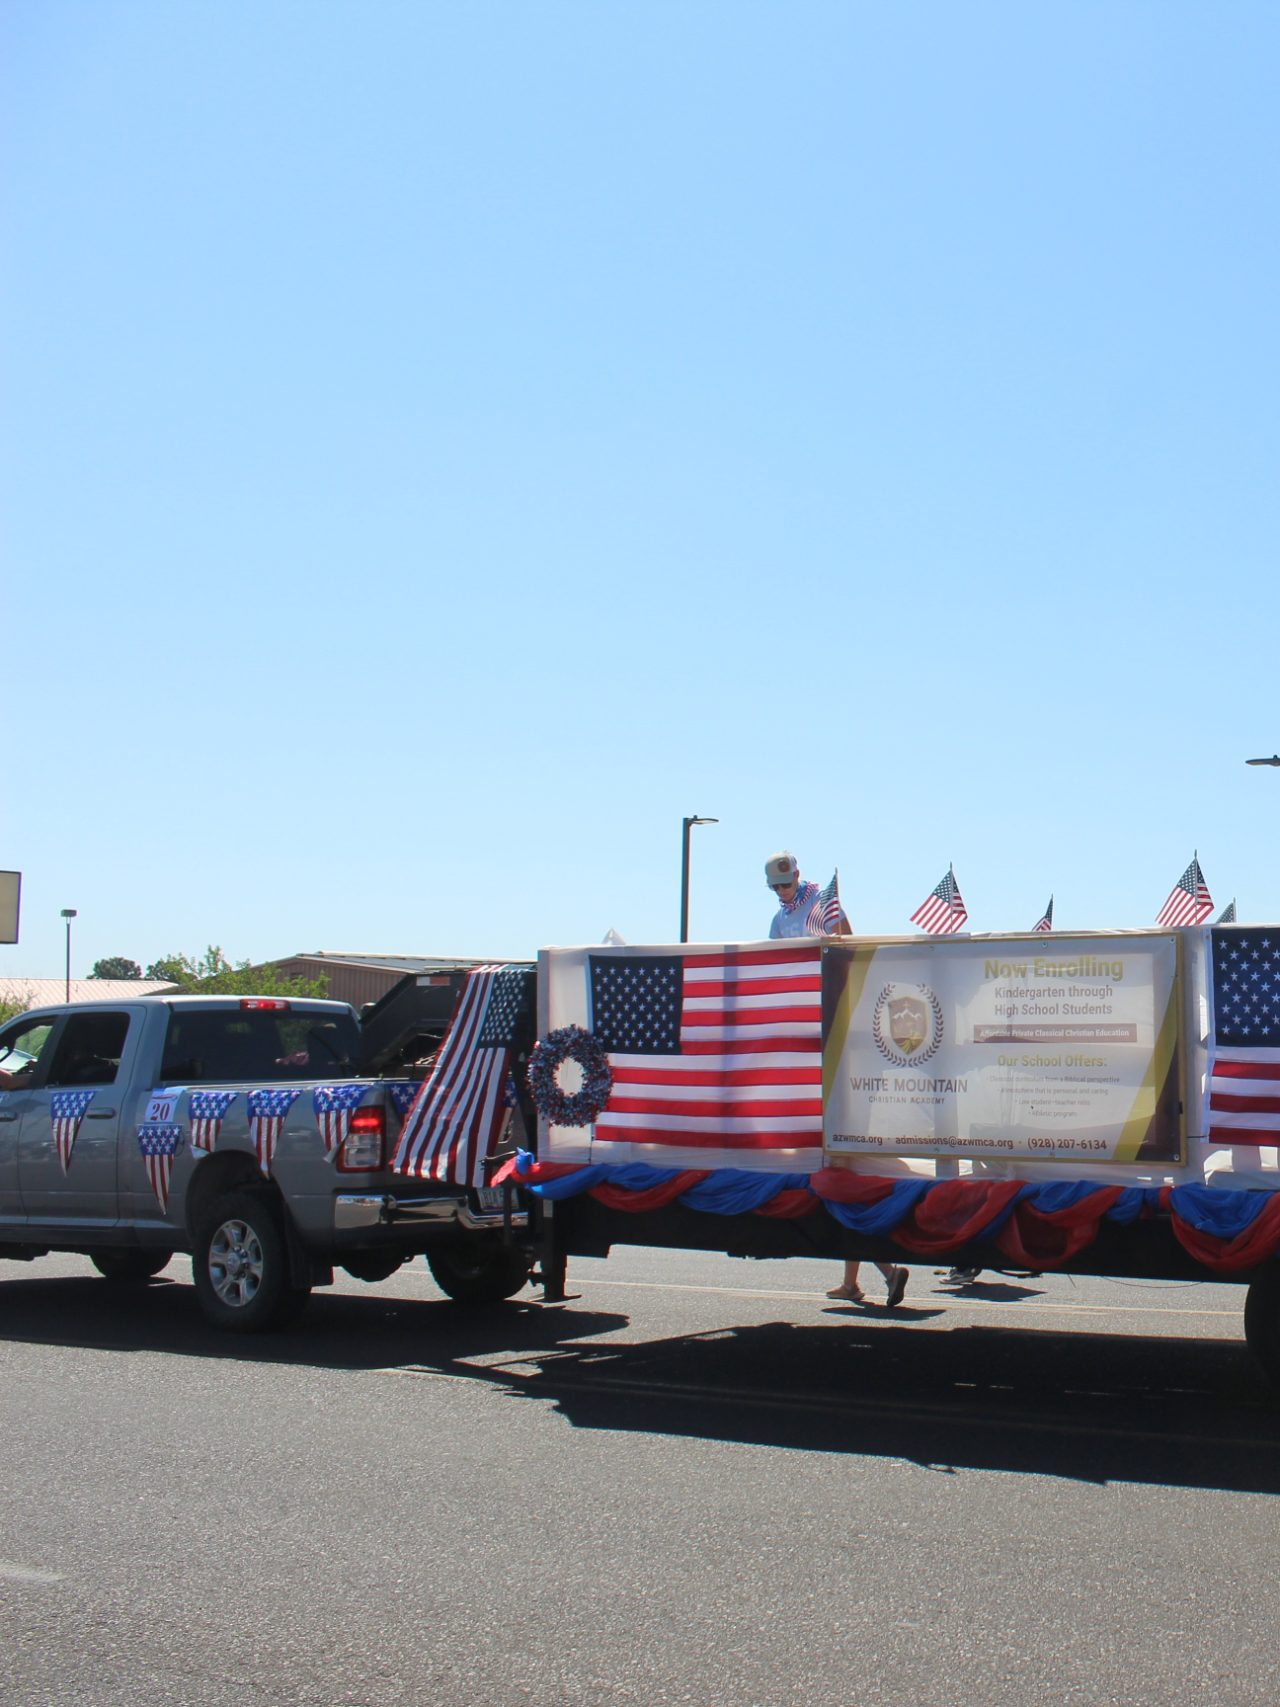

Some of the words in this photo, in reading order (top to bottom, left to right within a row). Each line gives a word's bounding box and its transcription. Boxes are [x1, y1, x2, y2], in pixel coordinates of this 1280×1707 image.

[984, 959, 1027, 979] Now
[1034, 956, 1124, 982] Enrolling
[994, 987, 1065, 1000] Kindergarten
[1068, 985, 1113, 999] through
[994, 1004, 1019, 1018] High
[1022, 1003, 1059, 1016] School
[1062, 1003, 1113, 1015] Students
[1095, 1028, 1130, 1037] Education
[997, 1056, 1018, 1067] Our
[1022, 1055, 1062, 1067] School
[1065, 1055, 1107, 1067] Offers:
[850, 1078, 889, 1091] WHITE
[894, 1079, 968, 1093] MOUNTAIN
[1087, 1075, 1120, 1085] perspective
[910, 1097, 945, 1105] ACADEMY
[150, 1103, 170, 1121] 20
[832, 1134, 883, 1146] azwmca.org
[896, 1135, 1014, 1150] admissions@azwmca.org
[1027, 1137, 1055, 1150] (928)
[1057, 1138, 1107, 1150] 207-6134
